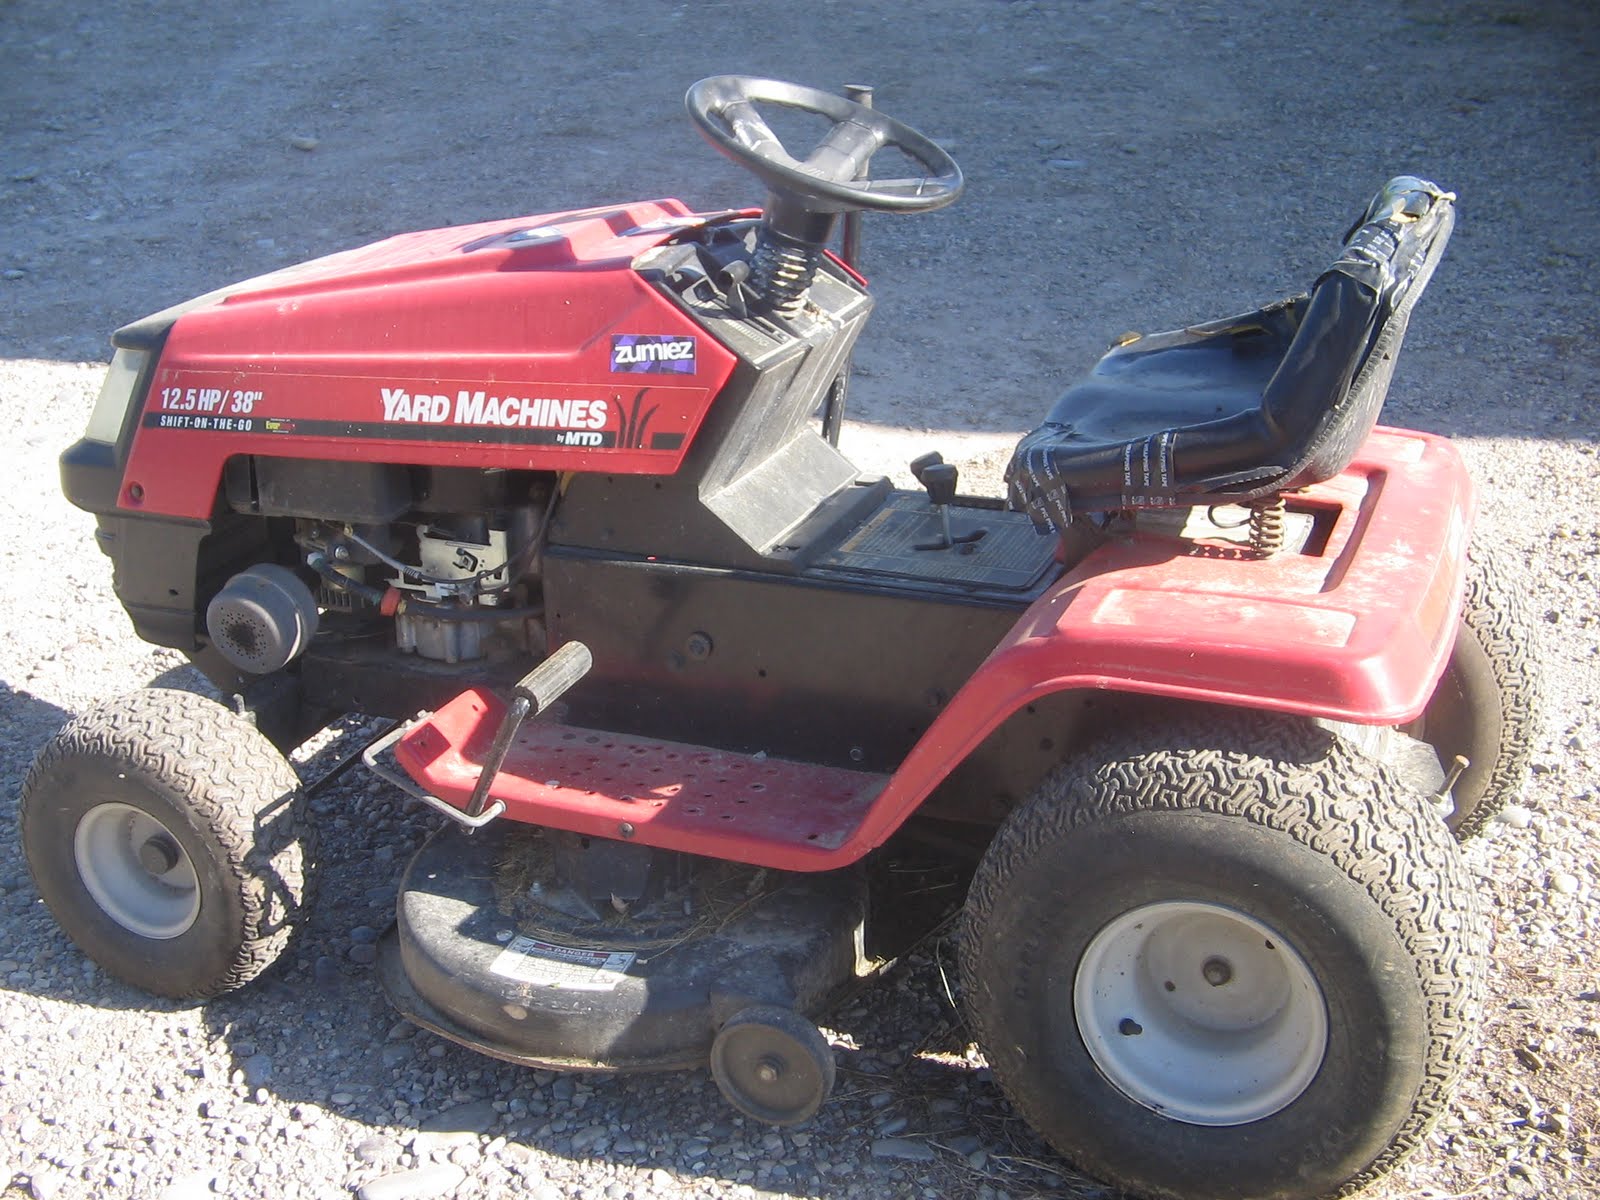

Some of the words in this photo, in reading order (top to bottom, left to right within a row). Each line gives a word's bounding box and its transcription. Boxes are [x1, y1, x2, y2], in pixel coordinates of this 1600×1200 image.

[615, 341, 694, 363] zumiez
[161, 387, 197, 411] 12.5
[231, 390, 264, 414] 38"
[380, 388, 451, 423] YARD
[453, 390, 608, 430] MACHINES
[160, 414, 253, 432] SHIFT-ON-THE-GO
[564, 431, 603, 446] MTD
